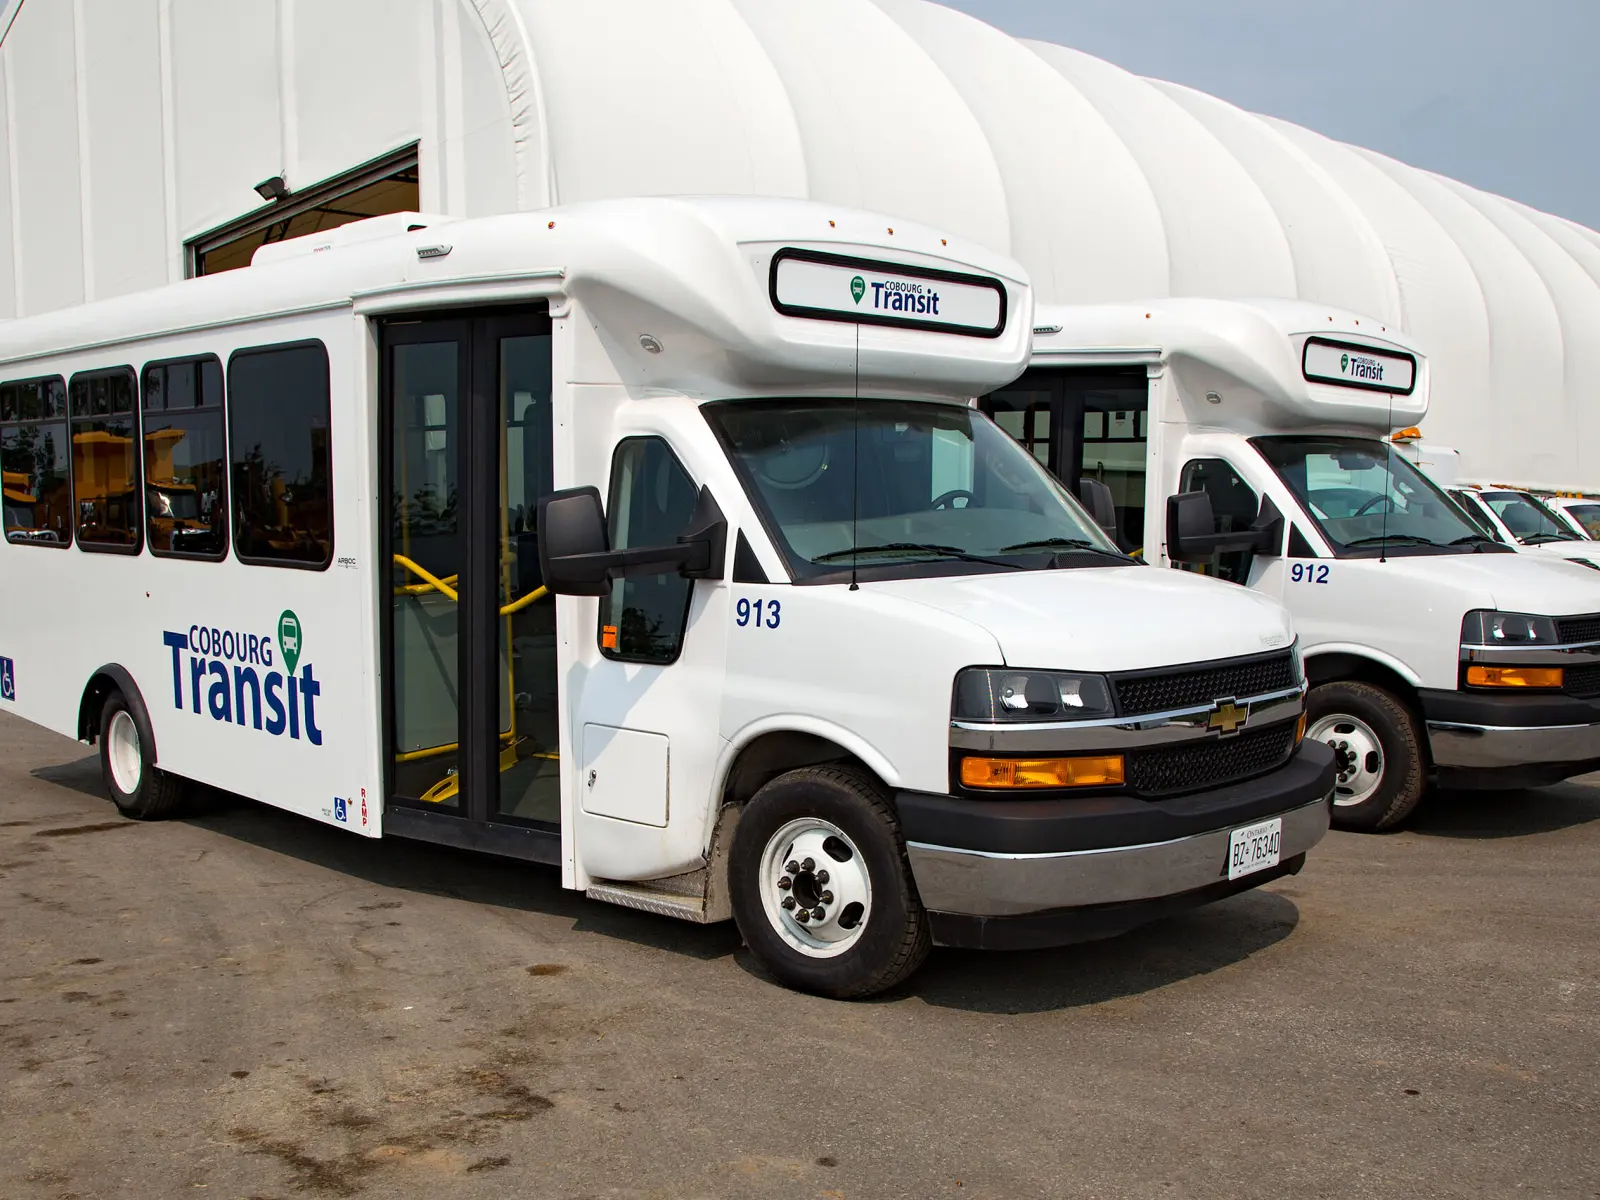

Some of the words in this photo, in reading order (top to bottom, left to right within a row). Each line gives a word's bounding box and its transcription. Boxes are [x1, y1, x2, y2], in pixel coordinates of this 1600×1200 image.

[871, 282, 940, 315] Transit
[884, 281, 922, 294] COBOURG
[1350, 358, 1384, 381] Transit
[1291, 563, 1330, 584] 912
[736, 597, 781, 629] 913
[189, 624, 273, 667] COBOURG
[162, 630, 323, 746] Transit
[360, 787, 368, 827] RAMP
